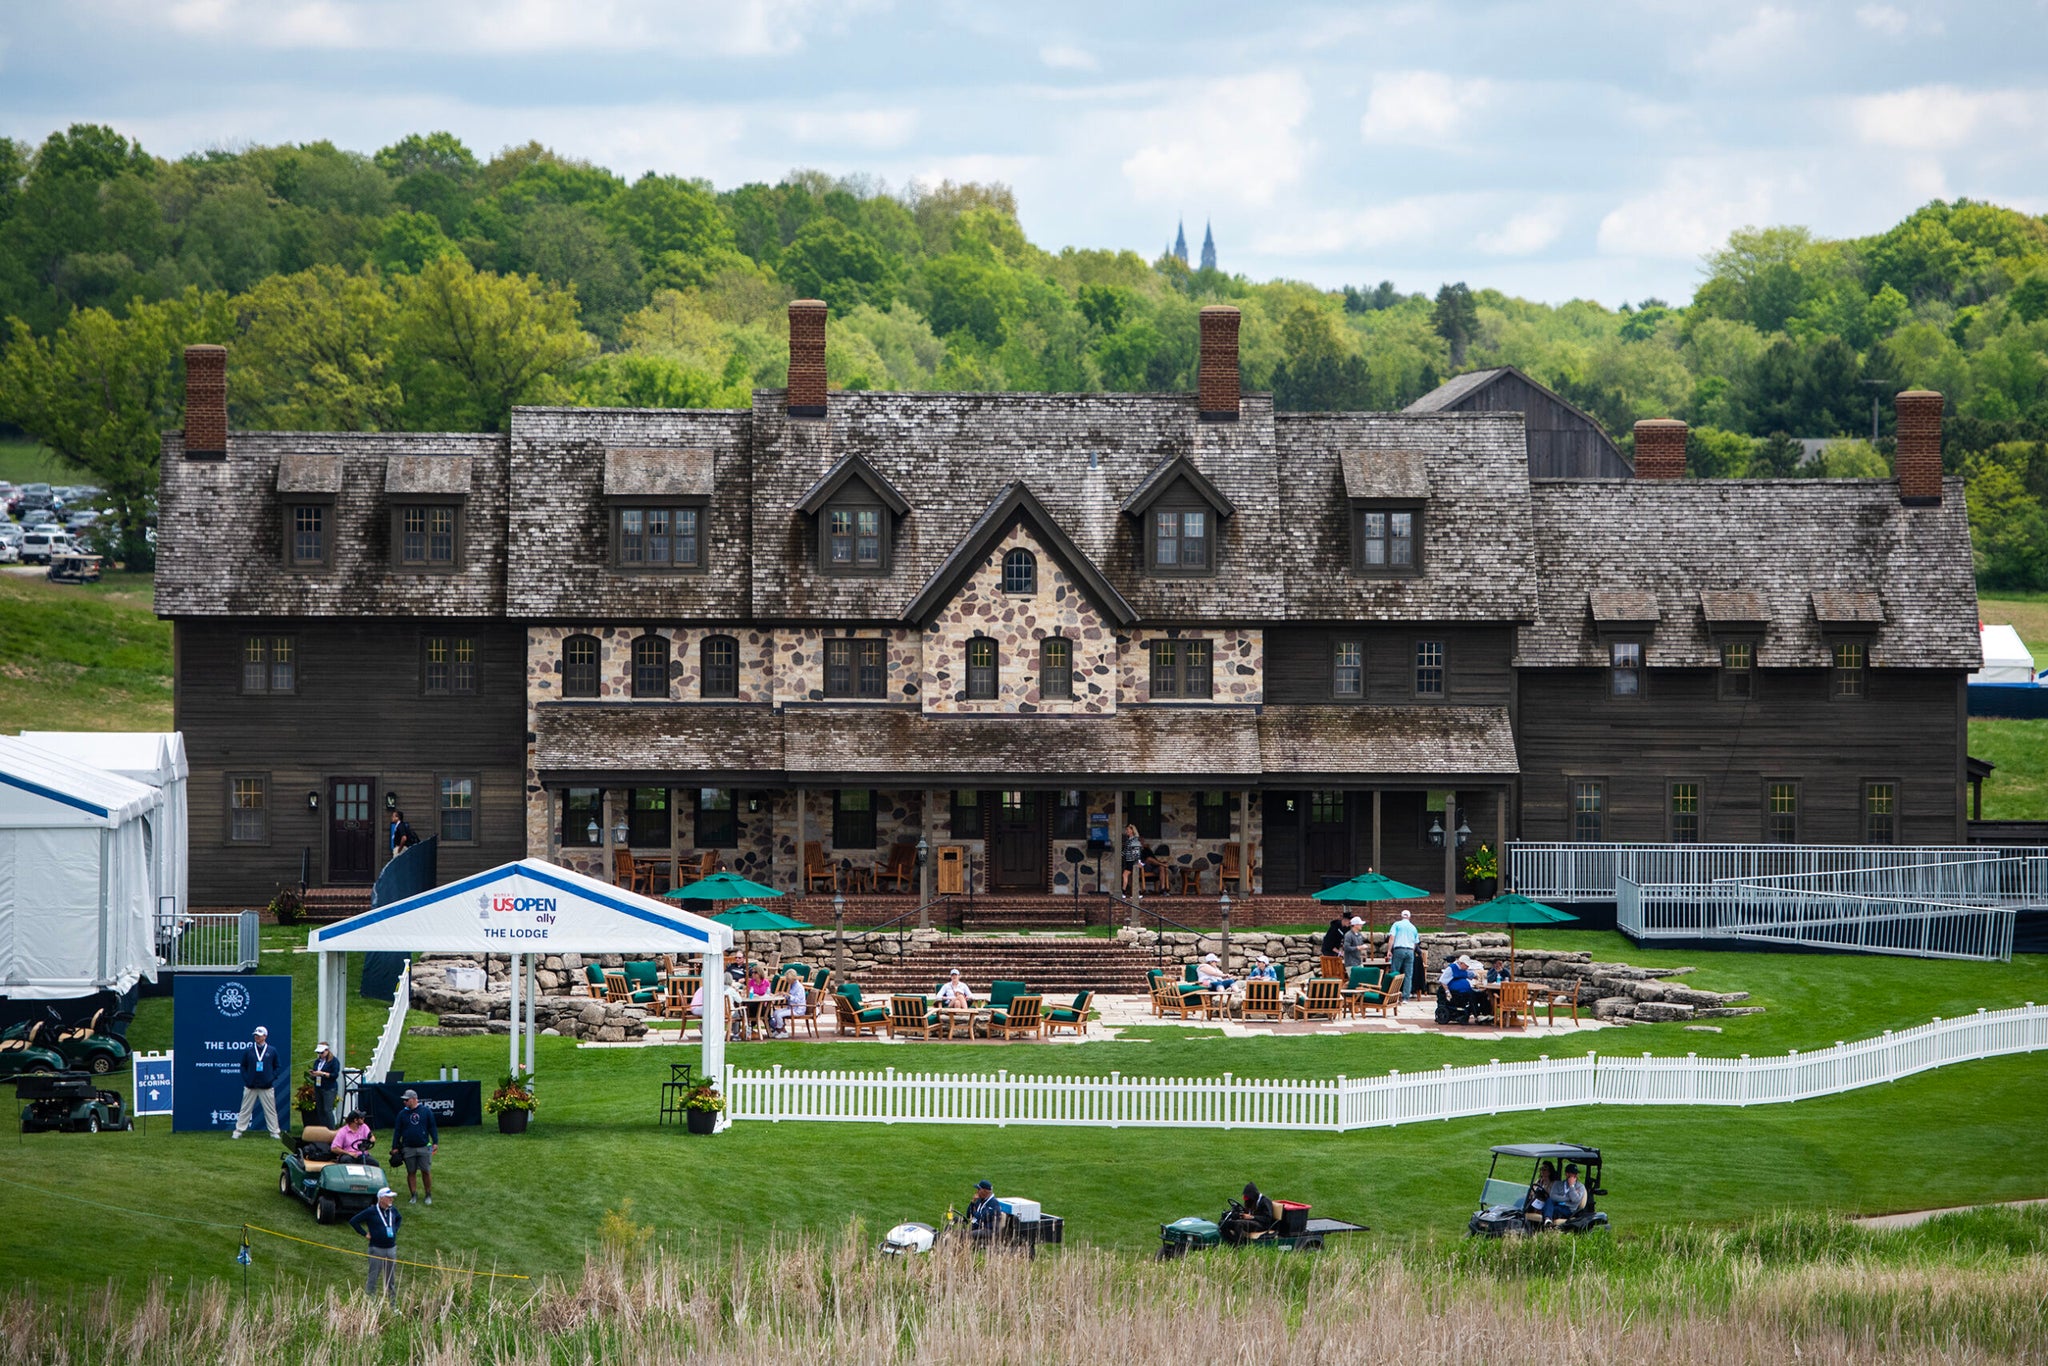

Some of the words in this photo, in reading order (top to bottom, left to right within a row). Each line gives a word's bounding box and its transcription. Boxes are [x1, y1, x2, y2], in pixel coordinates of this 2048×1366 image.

[536, 913, 556, 925] ally
[484, 928, 506, 938] THE
[510, 929, 548, 938] LODGE
[204, 1041, 225, 1050] THE
[139, 1079, 170, 1087] SCORING
